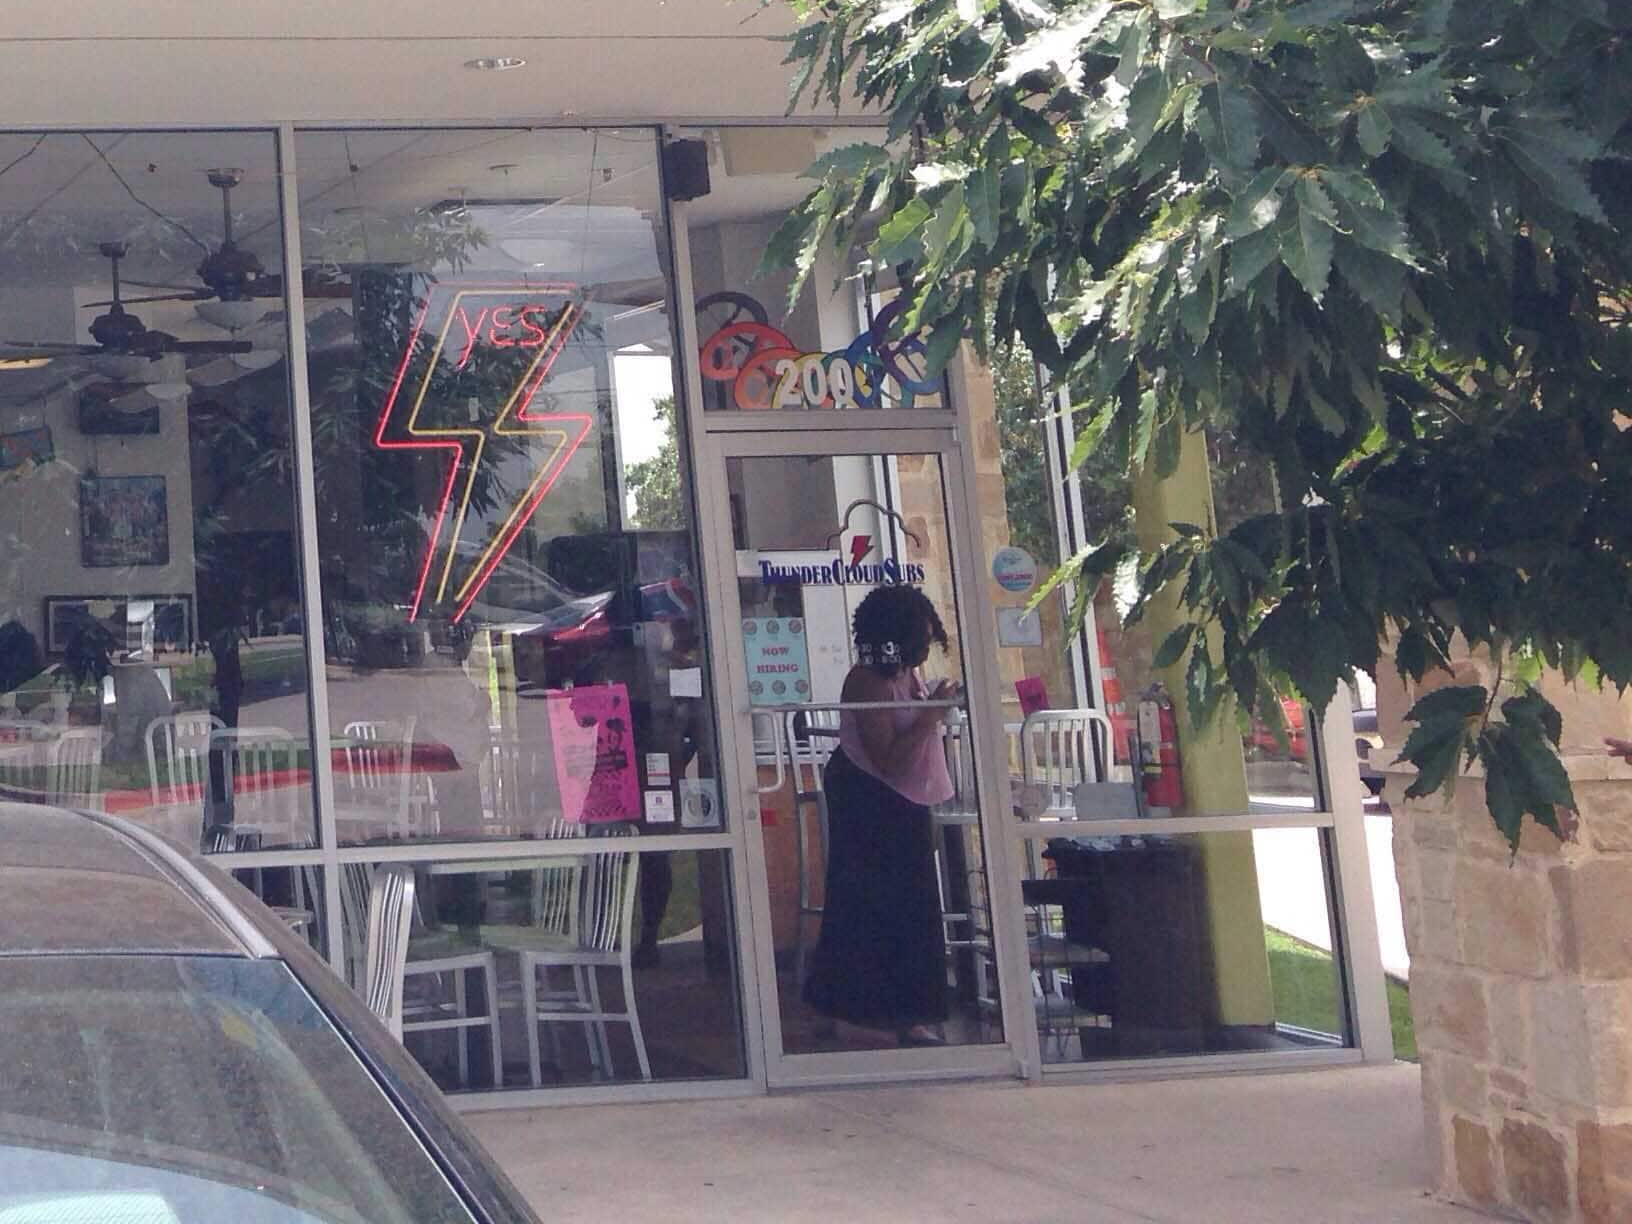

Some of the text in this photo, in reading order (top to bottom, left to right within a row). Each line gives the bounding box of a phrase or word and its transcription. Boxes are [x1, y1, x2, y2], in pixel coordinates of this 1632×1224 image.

[455, 301, 547, 370] YES
[761, 646, 791, 657] NOW
[756, 662, 800, 674] HIRING
